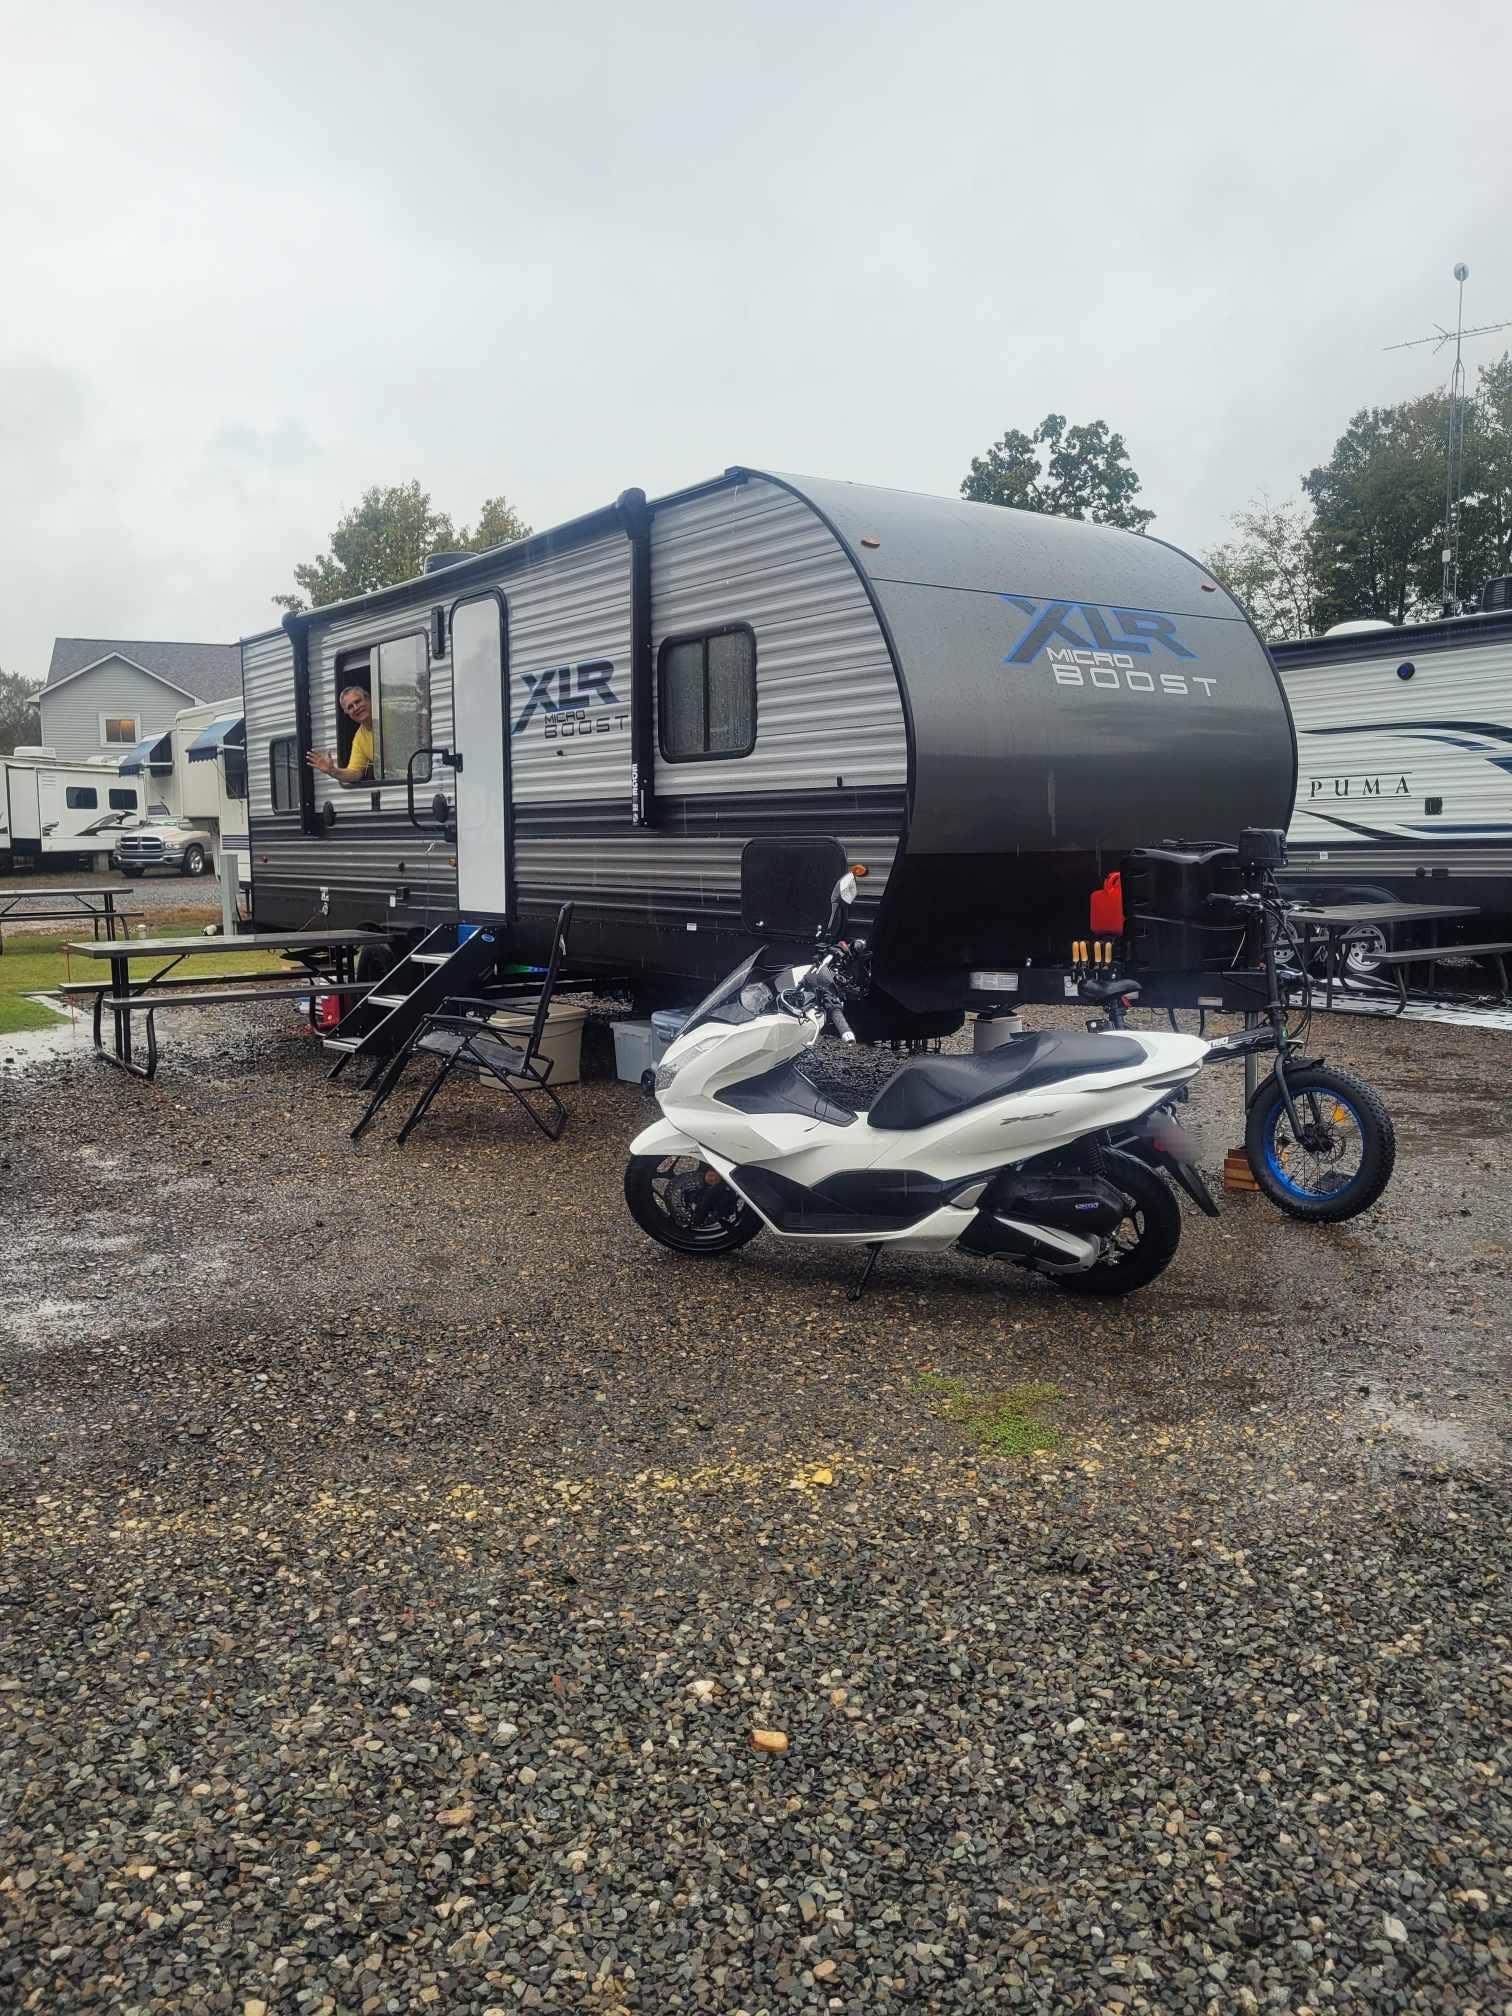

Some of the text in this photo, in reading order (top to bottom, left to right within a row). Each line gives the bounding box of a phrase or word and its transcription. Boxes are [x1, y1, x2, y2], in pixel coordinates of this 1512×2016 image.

[1002, 595, 1199, 664] XLR
[1047, 647, 1134, 669] MICRO
[1052, 664, 1217, 697] BOOST
[511, 659, 619, 736] XLR
[544, 710, 586, 724] MICRO
[544, 714, 628, 739] BOOST
[1311, 776, 1411, 798] PUMA
